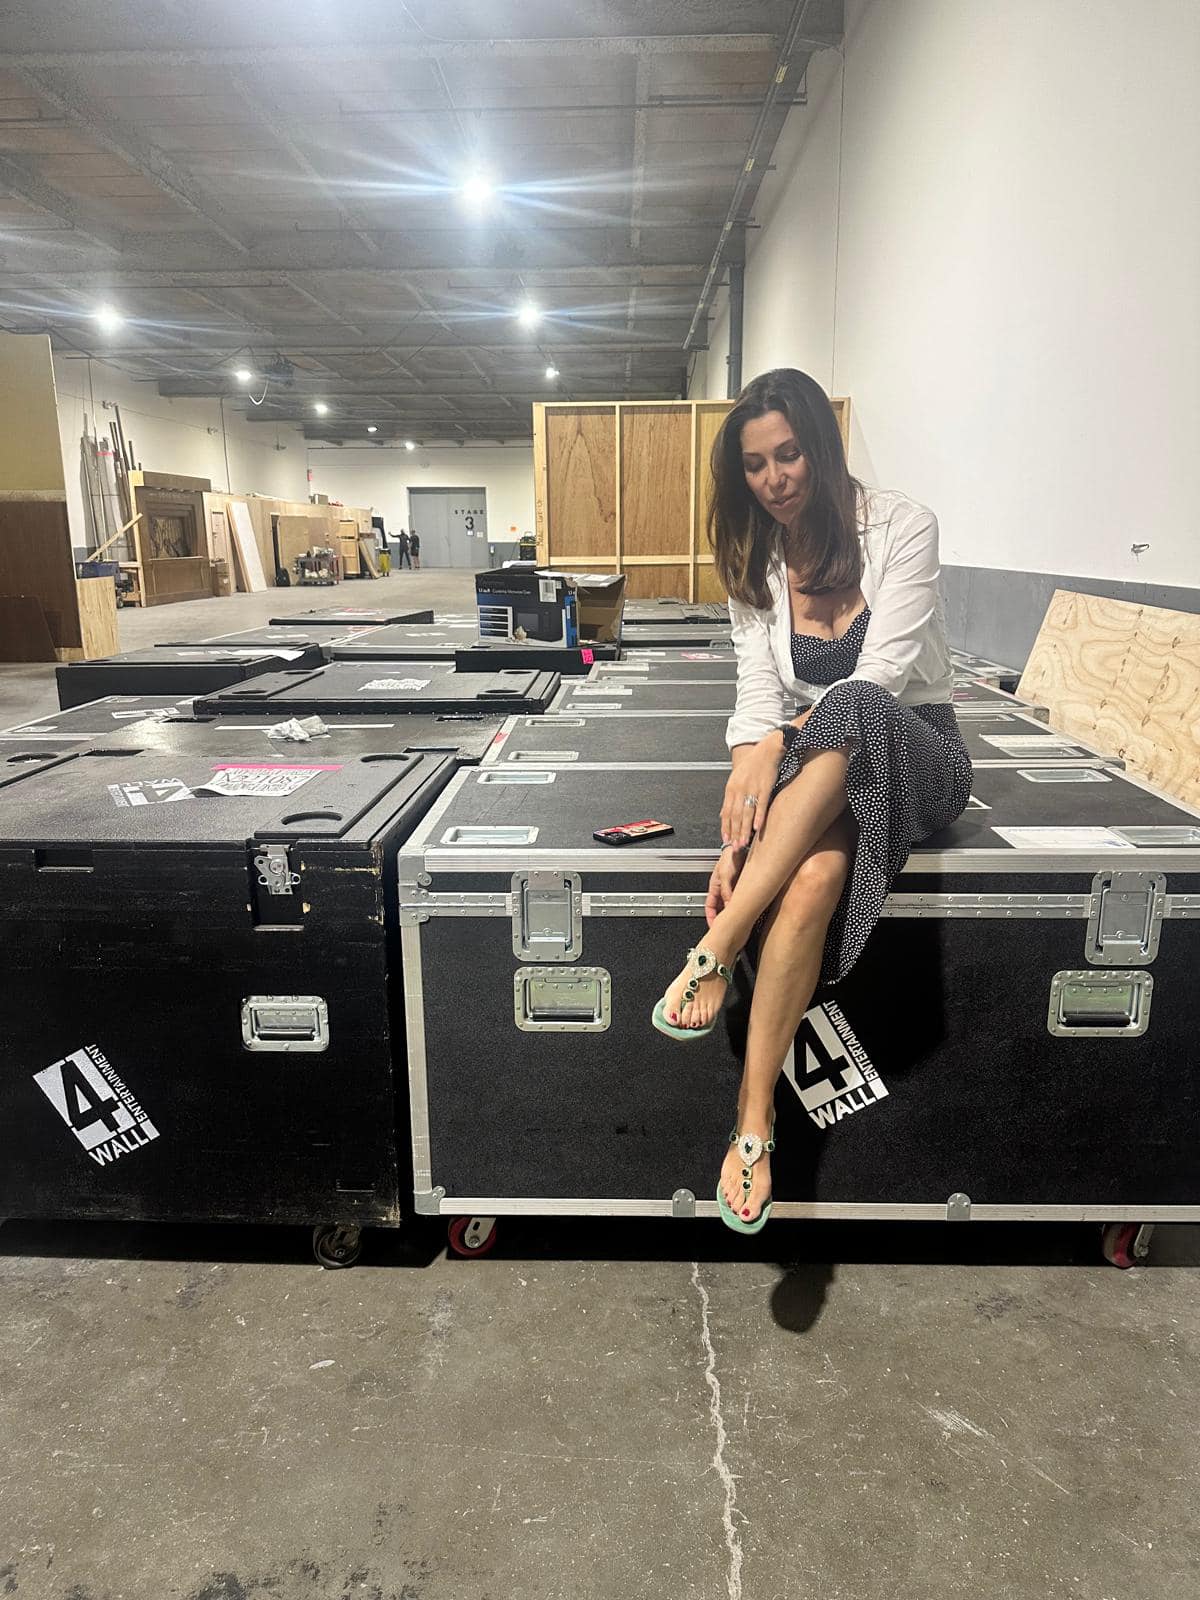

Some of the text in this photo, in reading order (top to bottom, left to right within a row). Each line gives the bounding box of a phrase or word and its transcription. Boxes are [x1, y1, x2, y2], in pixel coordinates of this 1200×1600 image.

[465, 516, 474, 530] 3
[793, 1016, 851, 1092] 4
[822, 1000, 879, 1082] ENTERTAINMENT
[60, 1059, 120, 1132] 4
[84, 1044, 148, 1123] ENTERTAINMENT
[808, 1088, 877, 1129] WALL
[88, 1129, 150, 1166] WALL
